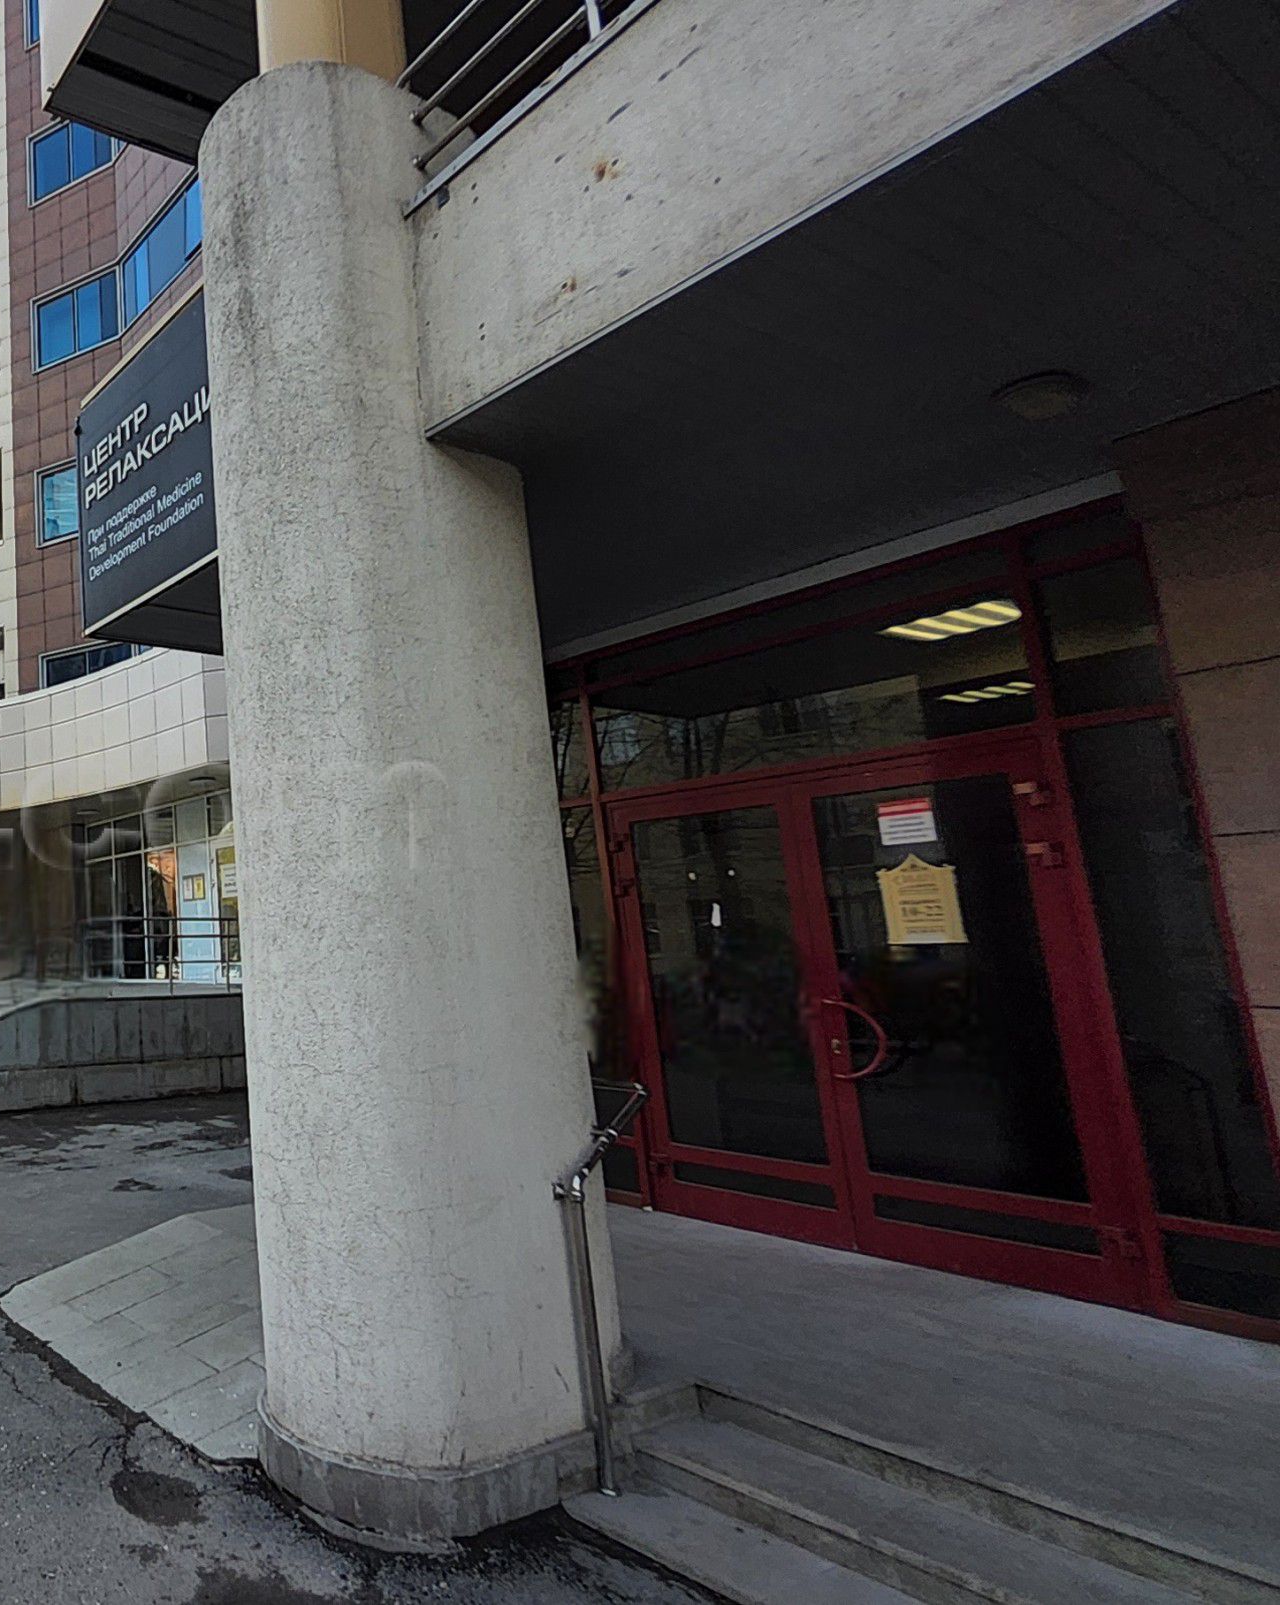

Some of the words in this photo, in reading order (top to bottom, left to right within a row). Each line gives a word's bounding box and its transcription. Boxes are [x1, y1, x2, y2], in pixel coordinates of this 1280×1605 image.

[84, 402, 148, 478] ЦЕНТР
[87, 524, 105, 545] При
[106, 485, 158, 531] поддержке
[88, 538, 107, 561] Thai
[107, 503, 156, 548] Traditional
[156, 471, 203, 514] Medicine
[88, 532, 146, 581] Development
[148, 492, 204, 541] Foundation
